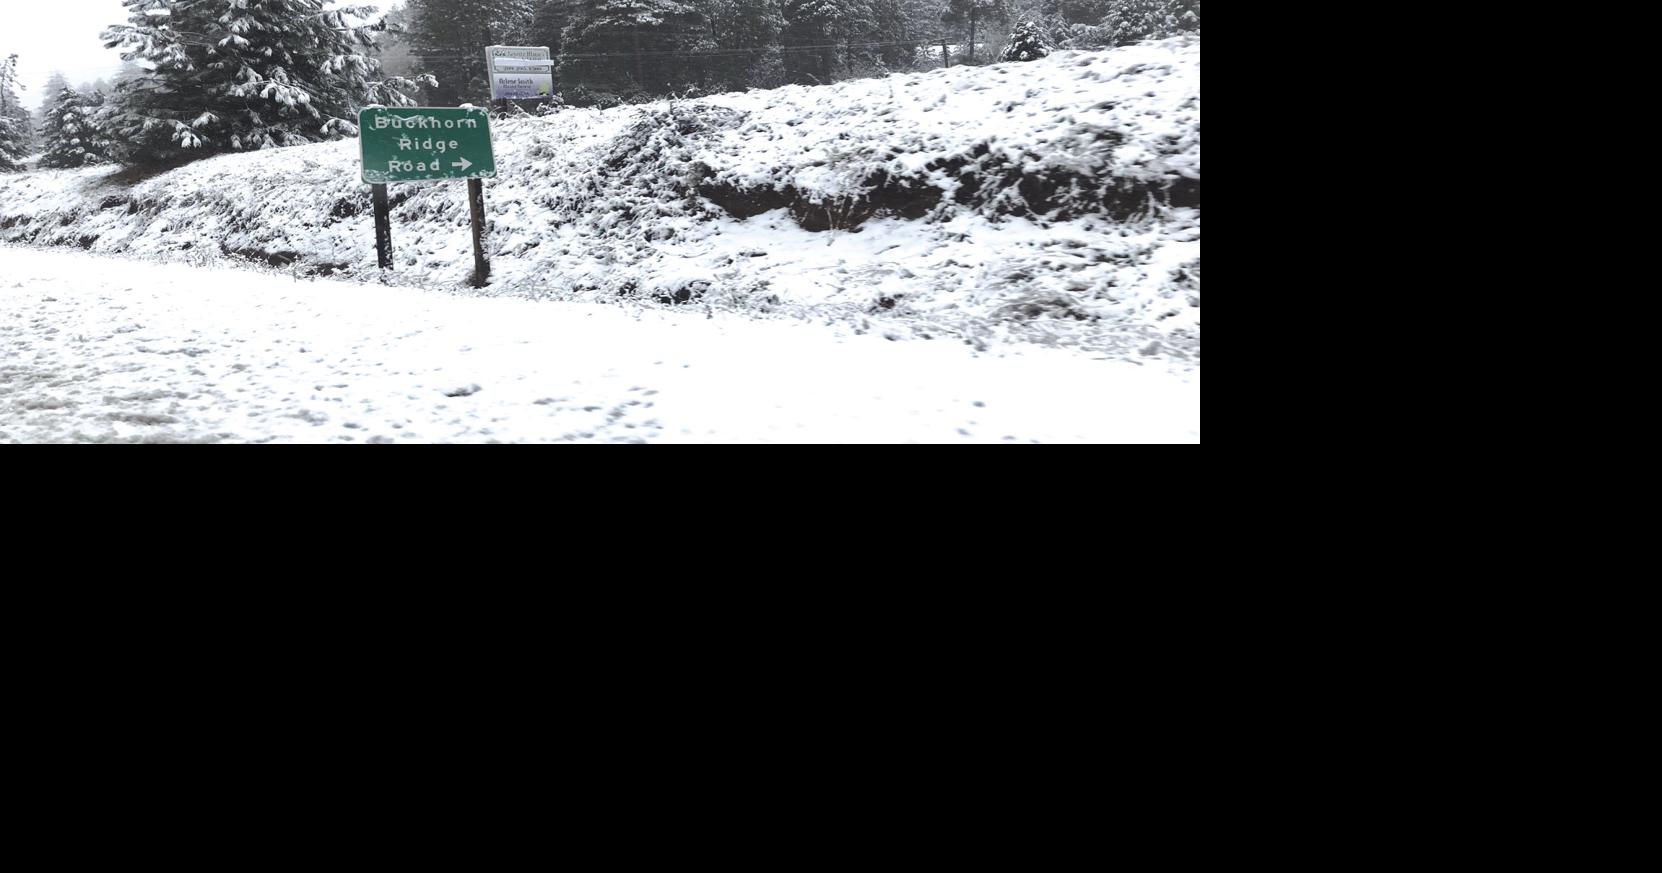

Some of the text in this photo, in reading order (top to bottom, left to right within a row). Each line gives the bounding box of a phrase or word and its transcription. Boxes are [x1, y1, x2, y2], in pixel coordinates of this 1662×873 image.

[375, 115, 477, 129] Buckhorn
[399, 137, 459, 154] Ridge
[388, 159, 440, 173] Road
